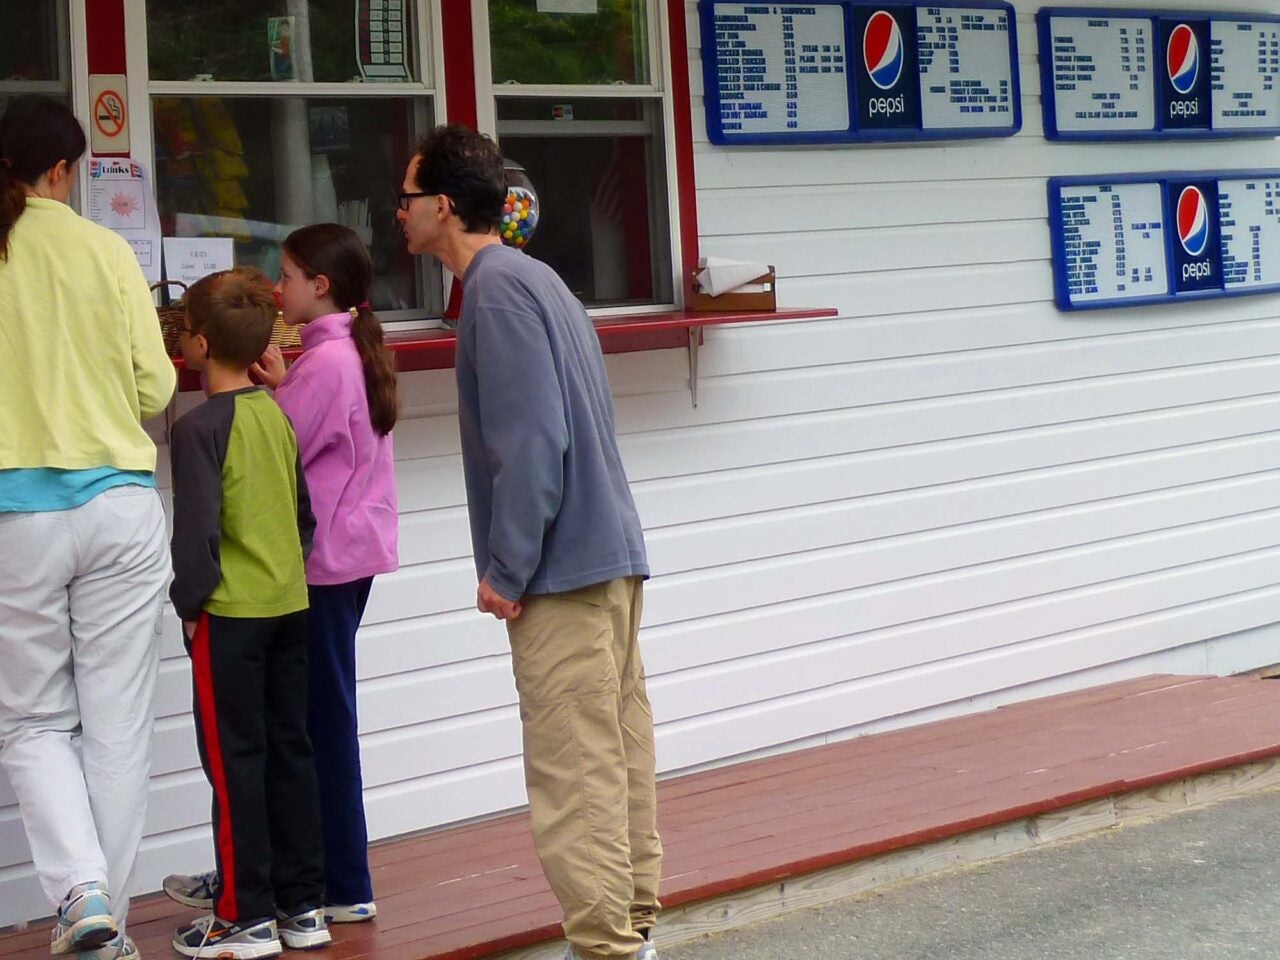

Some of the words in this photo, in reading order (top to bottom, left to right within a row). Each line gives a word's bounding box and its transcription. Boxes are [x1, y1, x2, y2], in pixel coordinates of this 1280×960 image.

[869, 94, 905, 118] pepsi
[1170, 97, 1198, 119] pepsi
[1182, 258, 1210, 279] pepsi
